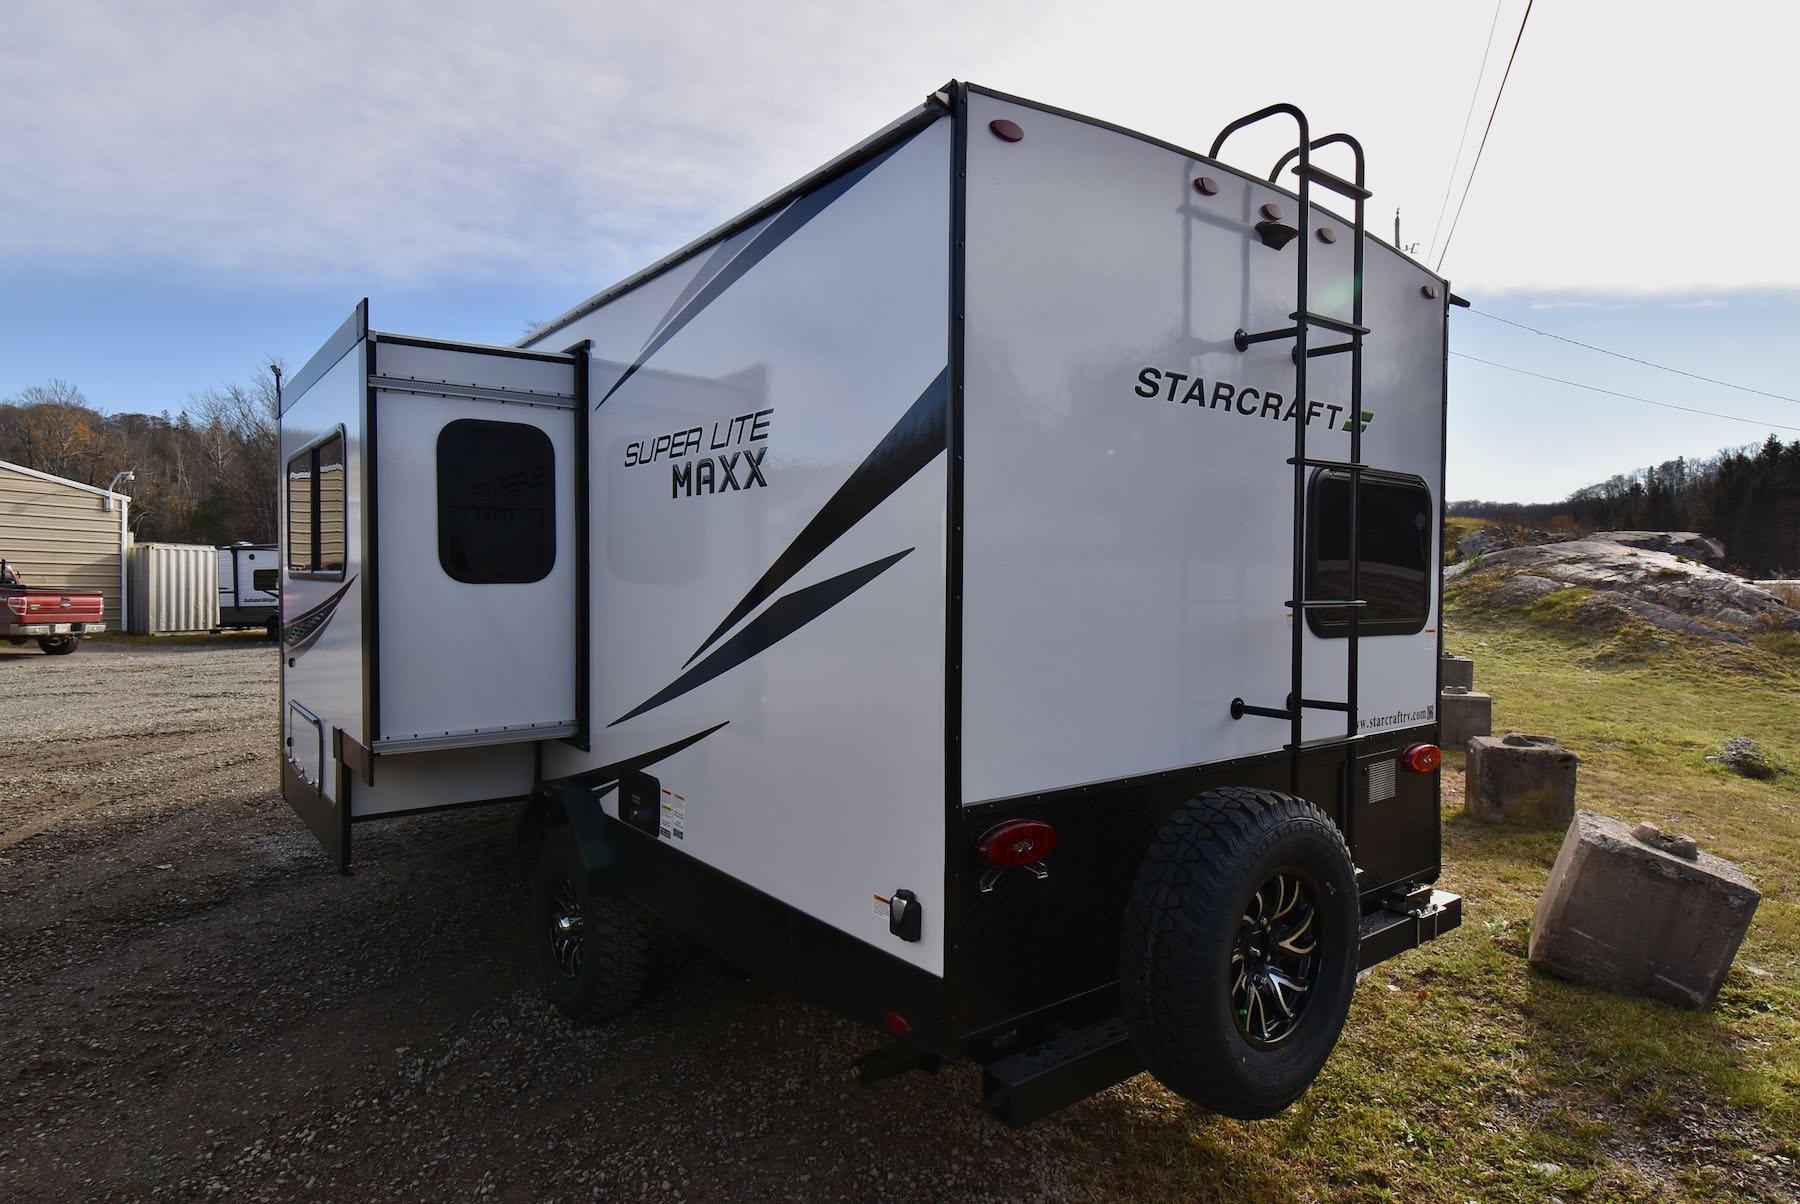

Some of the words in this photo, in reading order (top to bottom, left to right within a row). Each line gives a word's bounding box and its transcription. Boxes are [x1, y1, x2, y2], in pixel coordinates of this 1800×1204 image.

[1134, 367, 1343, 430] STARCRAFT
[624, 426, 703, 467] SUPER
[710, 408, 774, 450] LITE
[672, 447, 768, 498] MAXX
